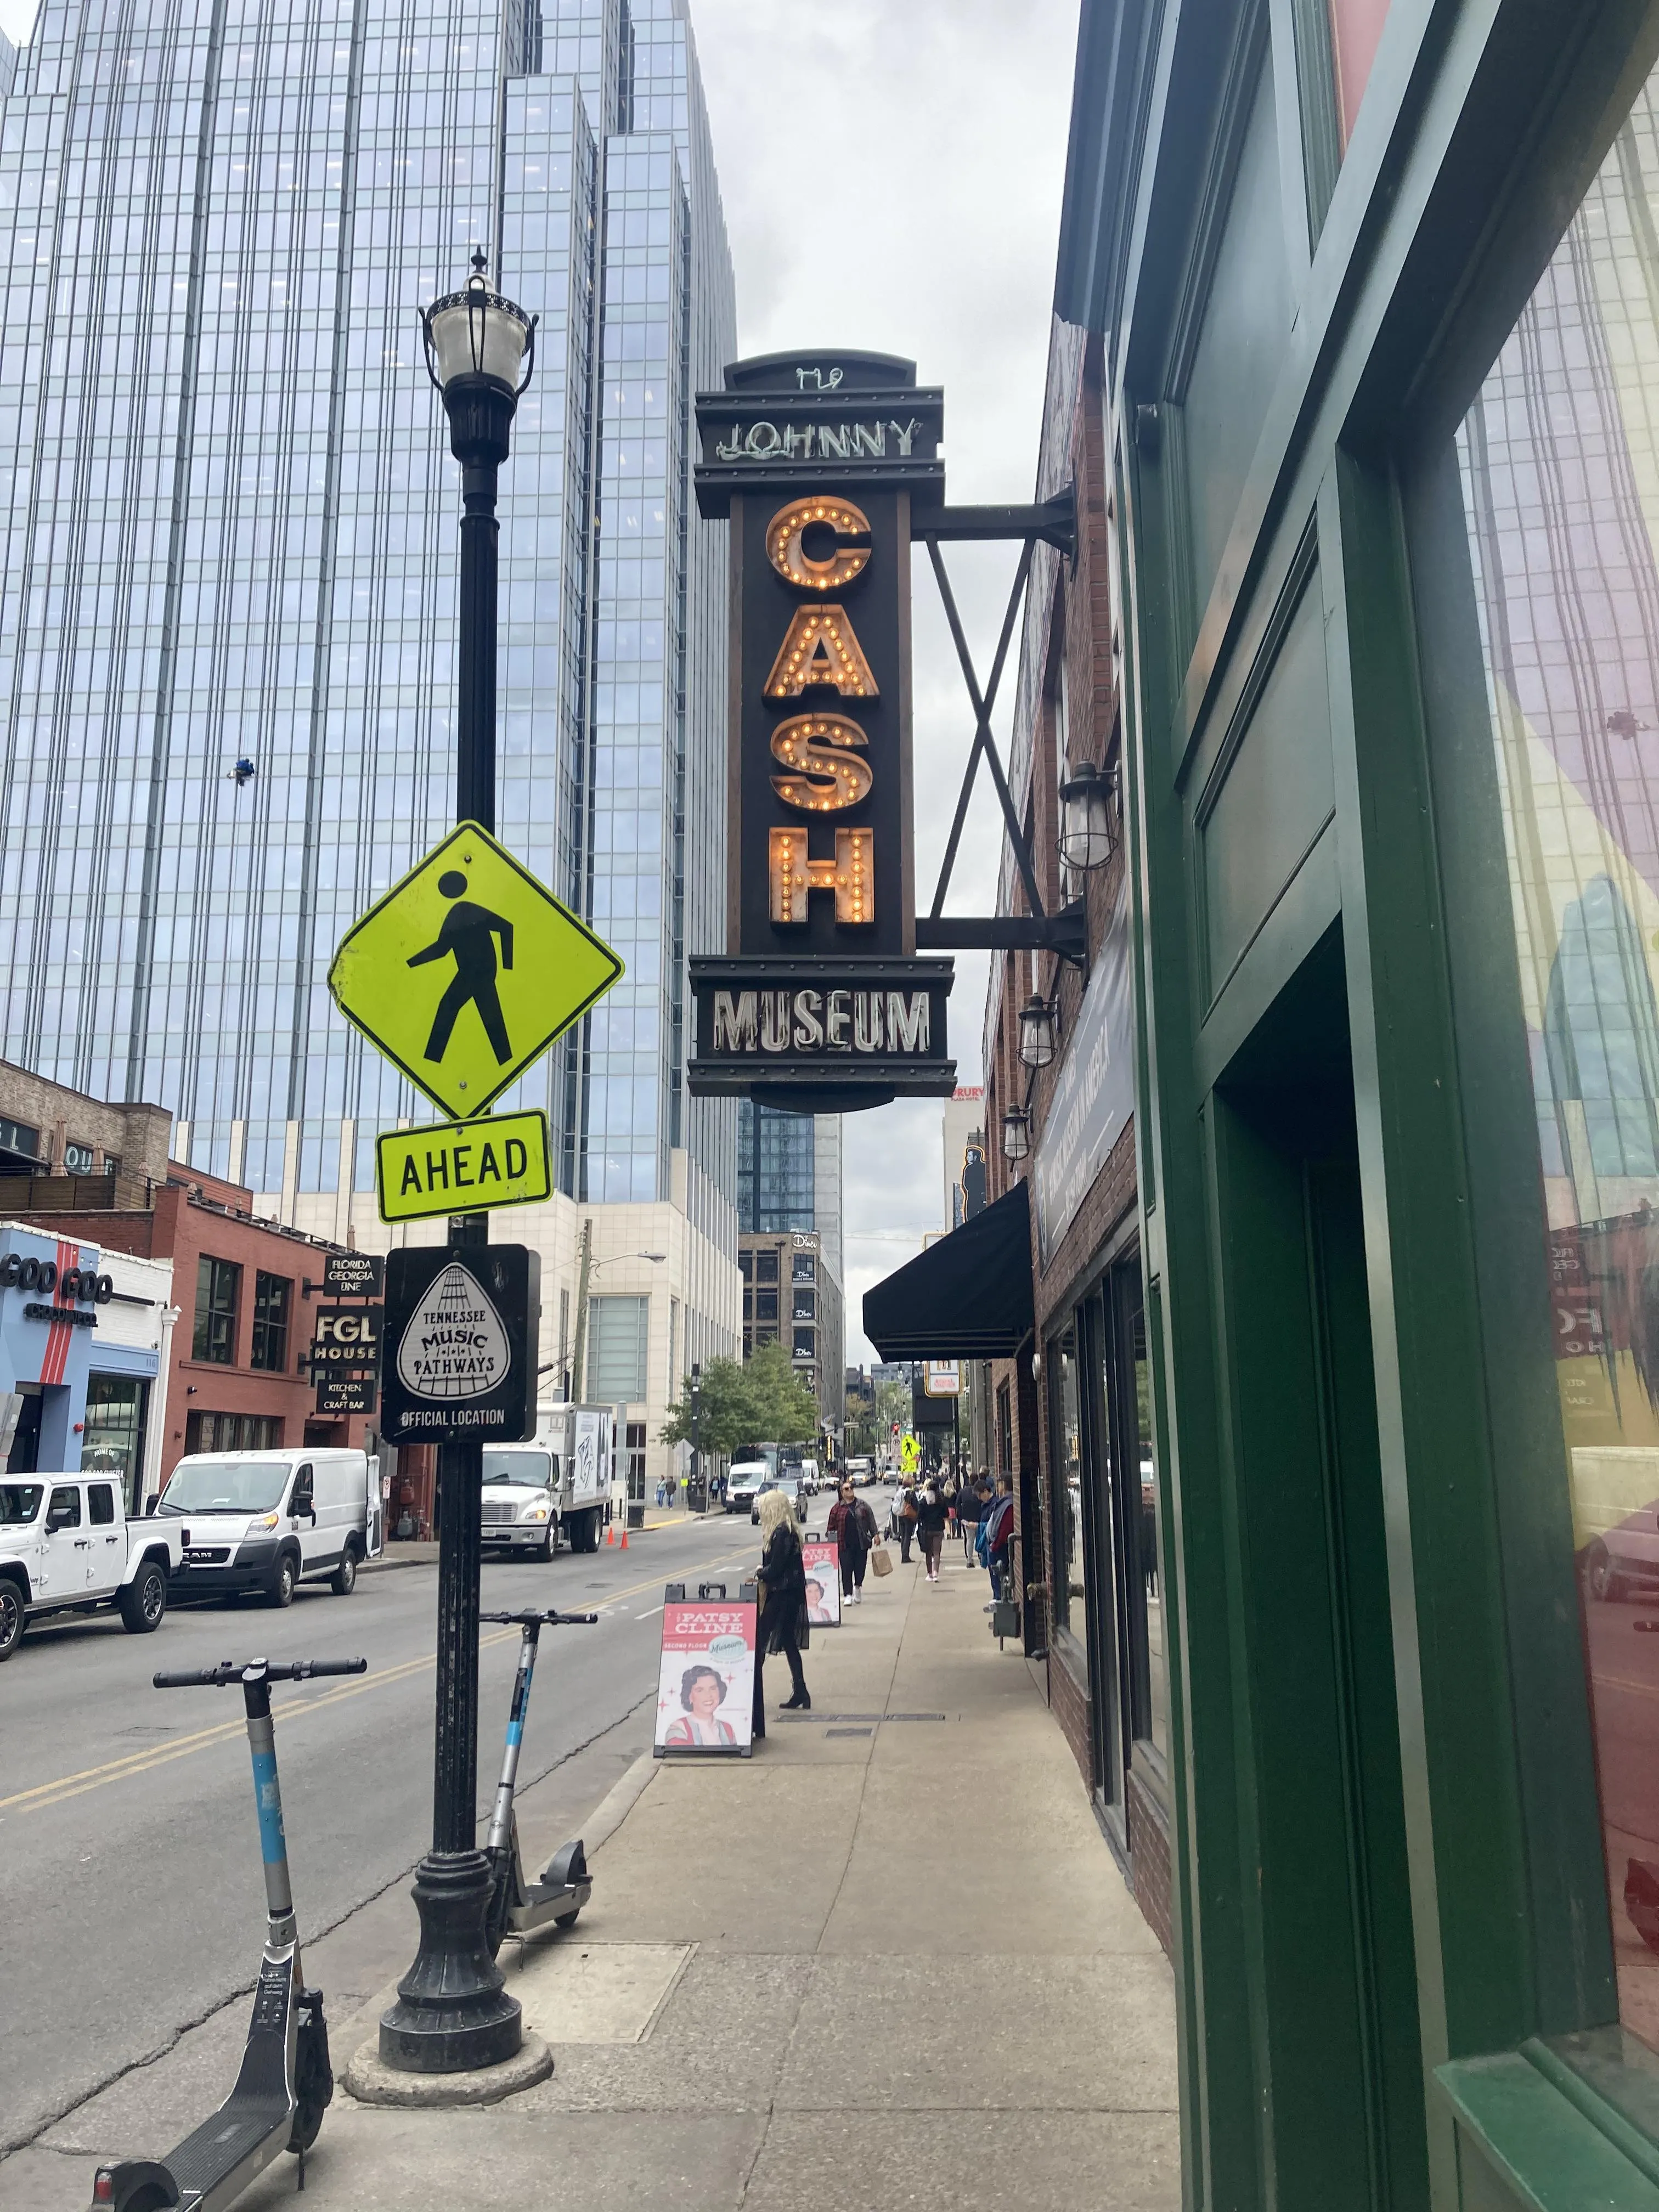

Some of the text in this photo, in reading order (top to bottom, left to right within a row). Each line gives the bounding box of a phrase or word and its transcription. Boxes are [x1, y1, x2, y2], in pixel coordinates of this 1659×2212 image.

[716, 418, 924, 460] JOHNNY
[761, 495, 881, 934] CASH
[713, 990, 930, 1052] MUSEUM
[400, 1139, 527, 1196] AHEAD
[793, 1235, 817, 1248] Diner
[332, 1259, 371, 1269] FLORIDA
[0, 1254, 113, 1304] GOO GOO
[328, 1271, 374, 1280] GEORGIA
[423, 1310, 486, 1324] TENNESSEE
[317, 1316, 376, 1342] FGL
[421, 1330, 488, 1351] MUSIC
[314, 1347, 376, 1359] HOUSE
[414, 1357, 494, 1375] PATHWAYS
[329, 1384, 362, 1392] KITCHEN
[401, 1409, 505, 1426] OFFICIAL LOCATION
[94, 1448, 115, 1458] HOME OF
[682, 1612, 743, 1622] PATSY
[675, 1623, 743, 1634] CLINE
